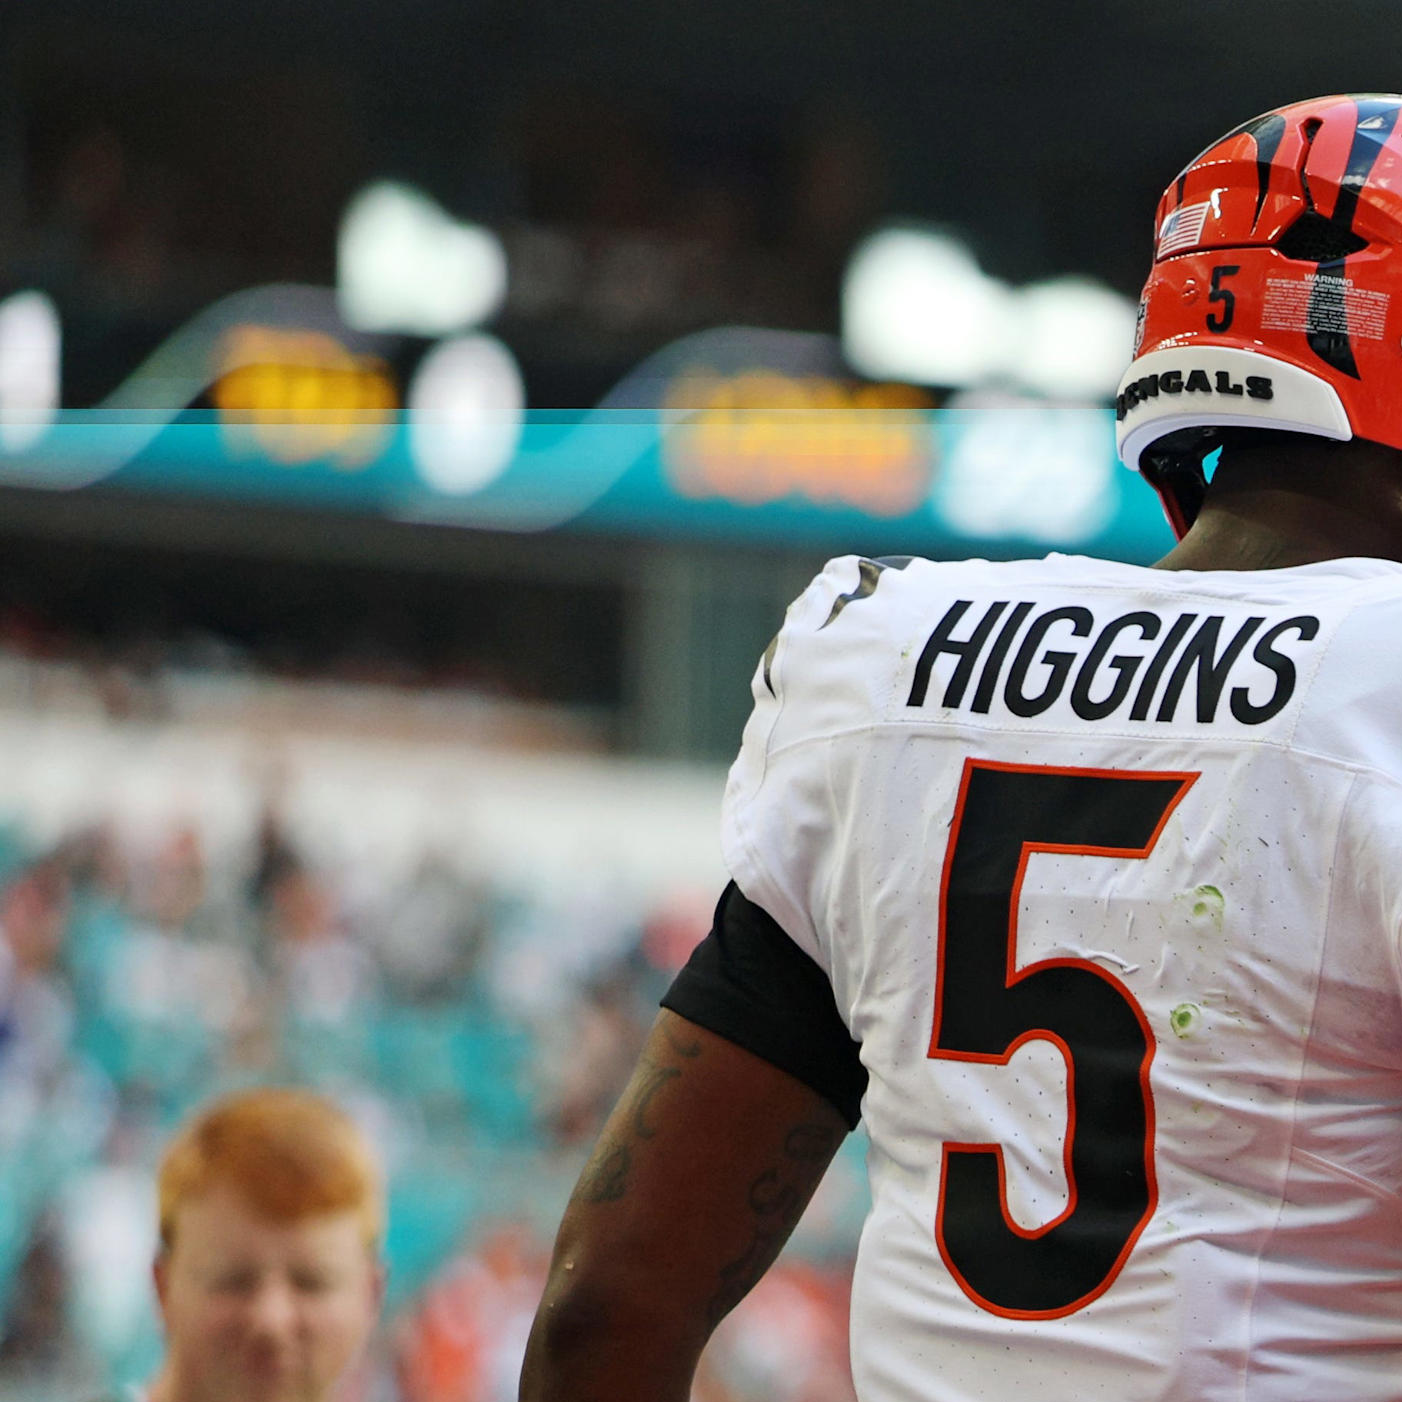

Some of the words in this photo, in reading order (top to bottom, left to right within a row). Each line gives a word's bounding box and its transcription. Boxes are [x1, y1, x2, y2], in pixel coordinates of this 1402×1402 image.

[1206, 265, 1240, 334] 5
[1304, 273, 1354, 288] WARNING
[906, 600, 1320, 726] HIGGINS
[927, 757, 1201, 1320] 5
